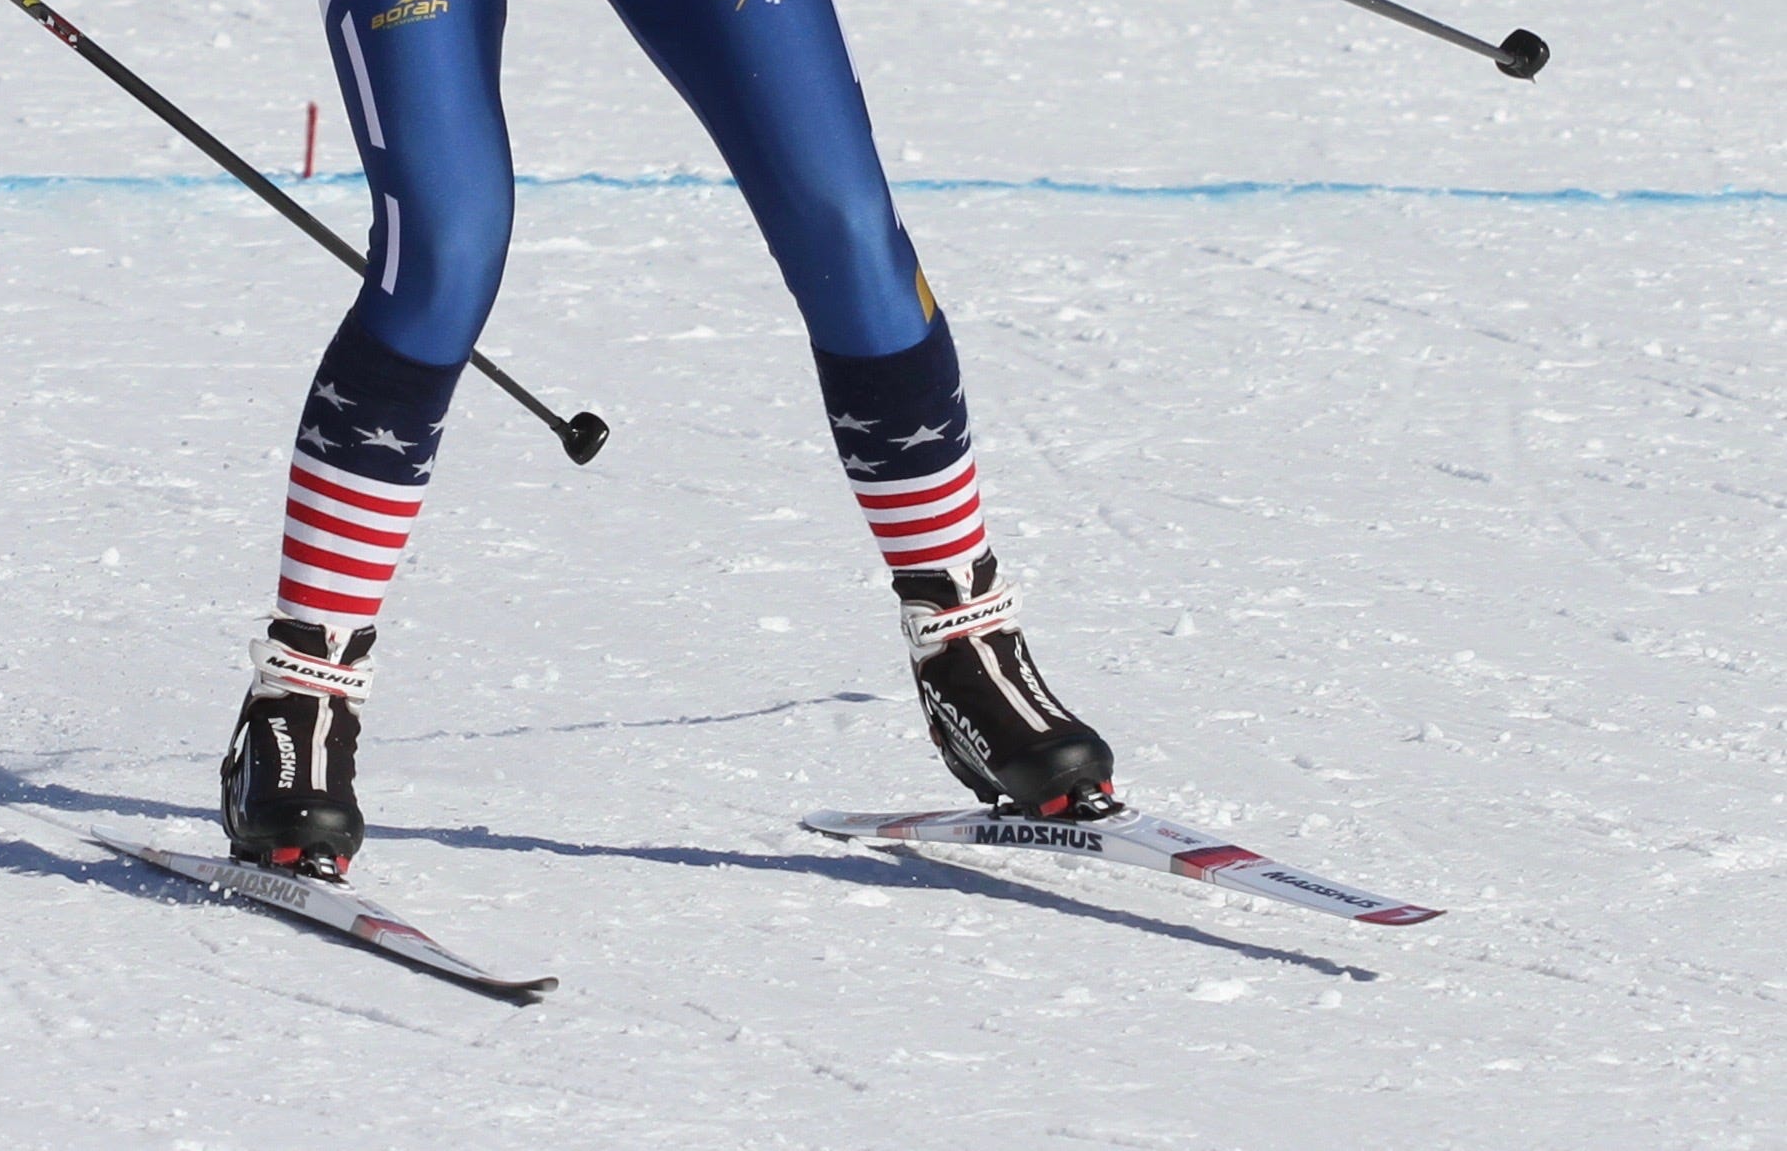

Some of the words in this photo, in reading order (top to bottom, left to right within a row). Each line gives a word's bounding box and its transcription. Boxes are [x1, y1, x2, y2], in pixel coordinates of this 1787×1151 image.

[919, 596, 1014, 636] MADSHUS
[265, 655, 366, 688] MADSHUS
[267, 716, 297, 789] MADSHUS
[975, 824, 1104, 853] MADSHUS
[212, 866, 311, 909] MADSHUS
[1260, 870, 1384, 909] MADSHUS
